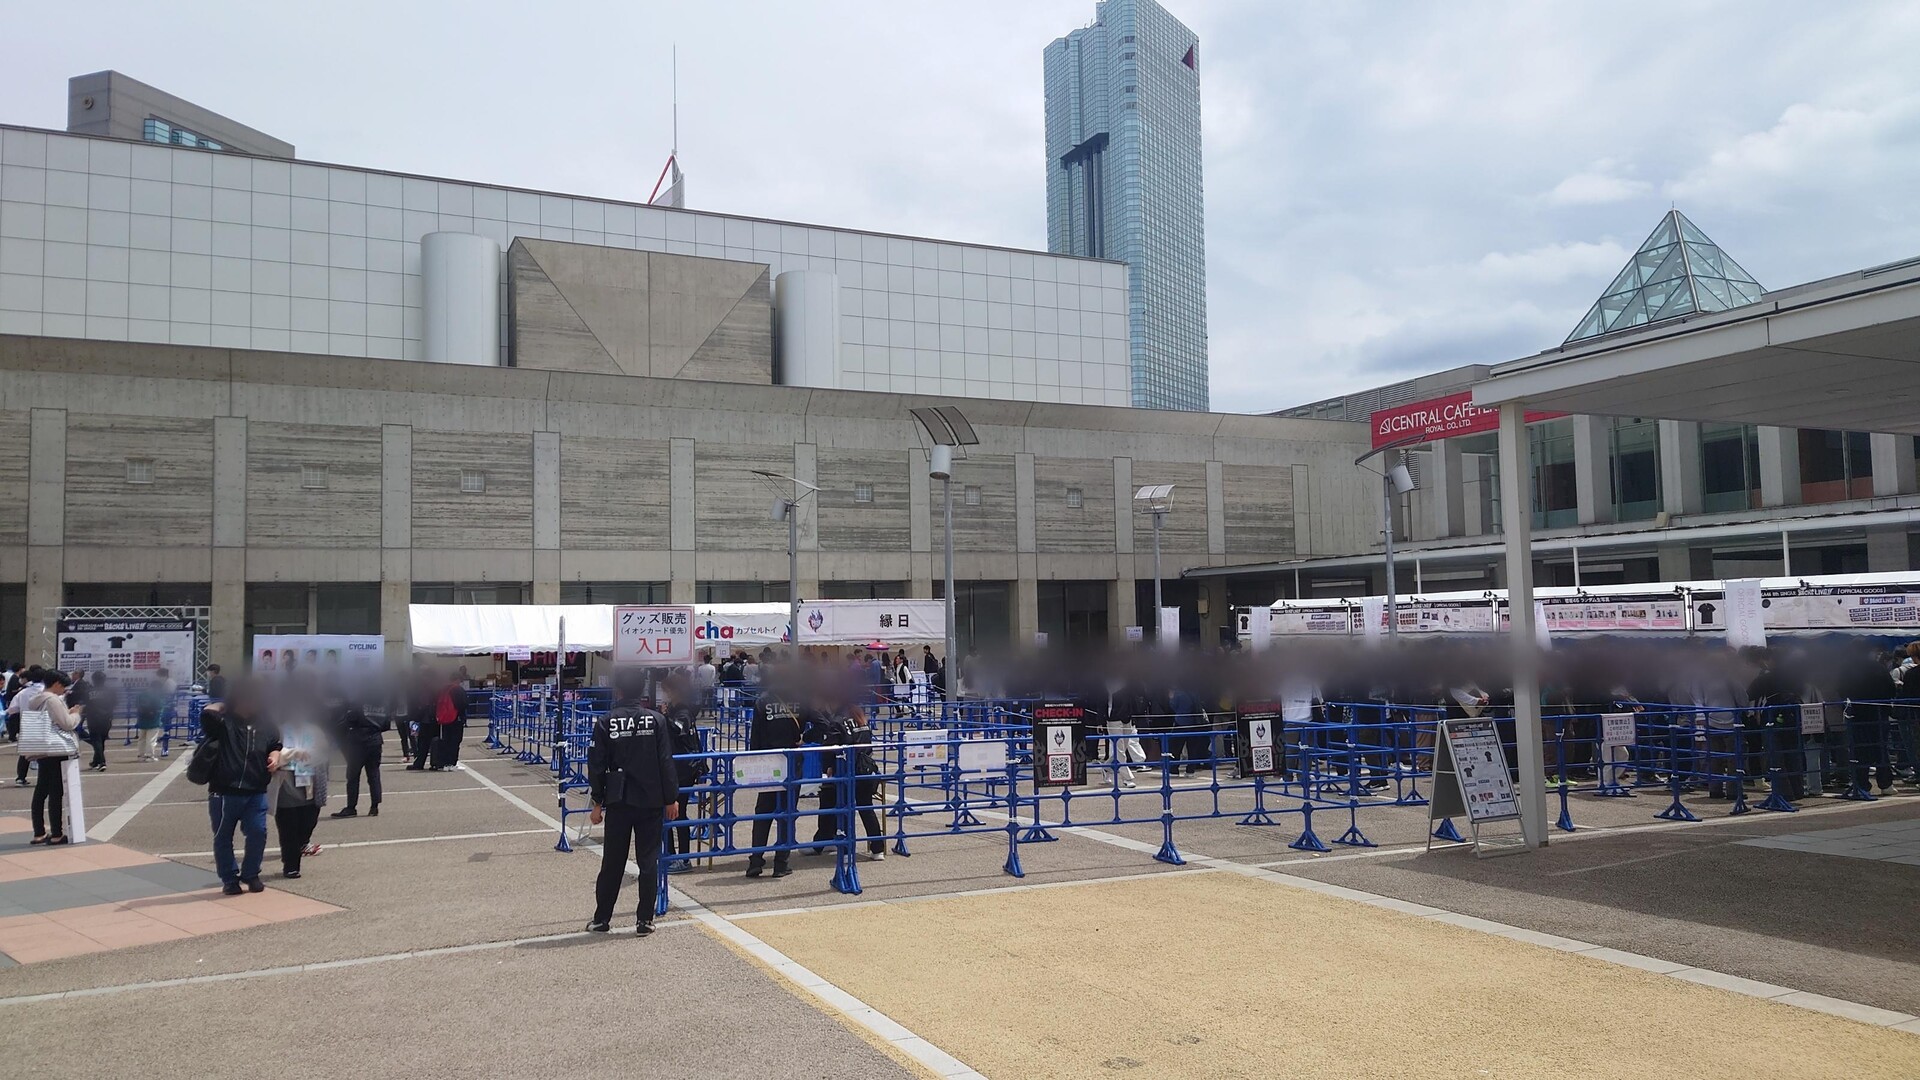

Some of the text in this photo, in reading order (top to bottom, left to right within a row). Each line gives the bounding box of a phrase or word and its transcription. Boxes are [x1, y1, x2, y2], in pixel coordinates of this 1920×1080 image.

[1391, 408, 1441, 431] CENTRAL
[1425, 424, 1445, 434] ROYAL
[622, 612, 687, 625] グッズ販売
[879, 614, 909, 628] 縁日
[736, 626, 777, 634] カプセルトイ
[636, 638, 672, 654] 入口
[765, 702, 800, 714] STAFF
[1035, 708, 1083, 718] CHECK-IN
[609, 716, 653, 731] STAFF
